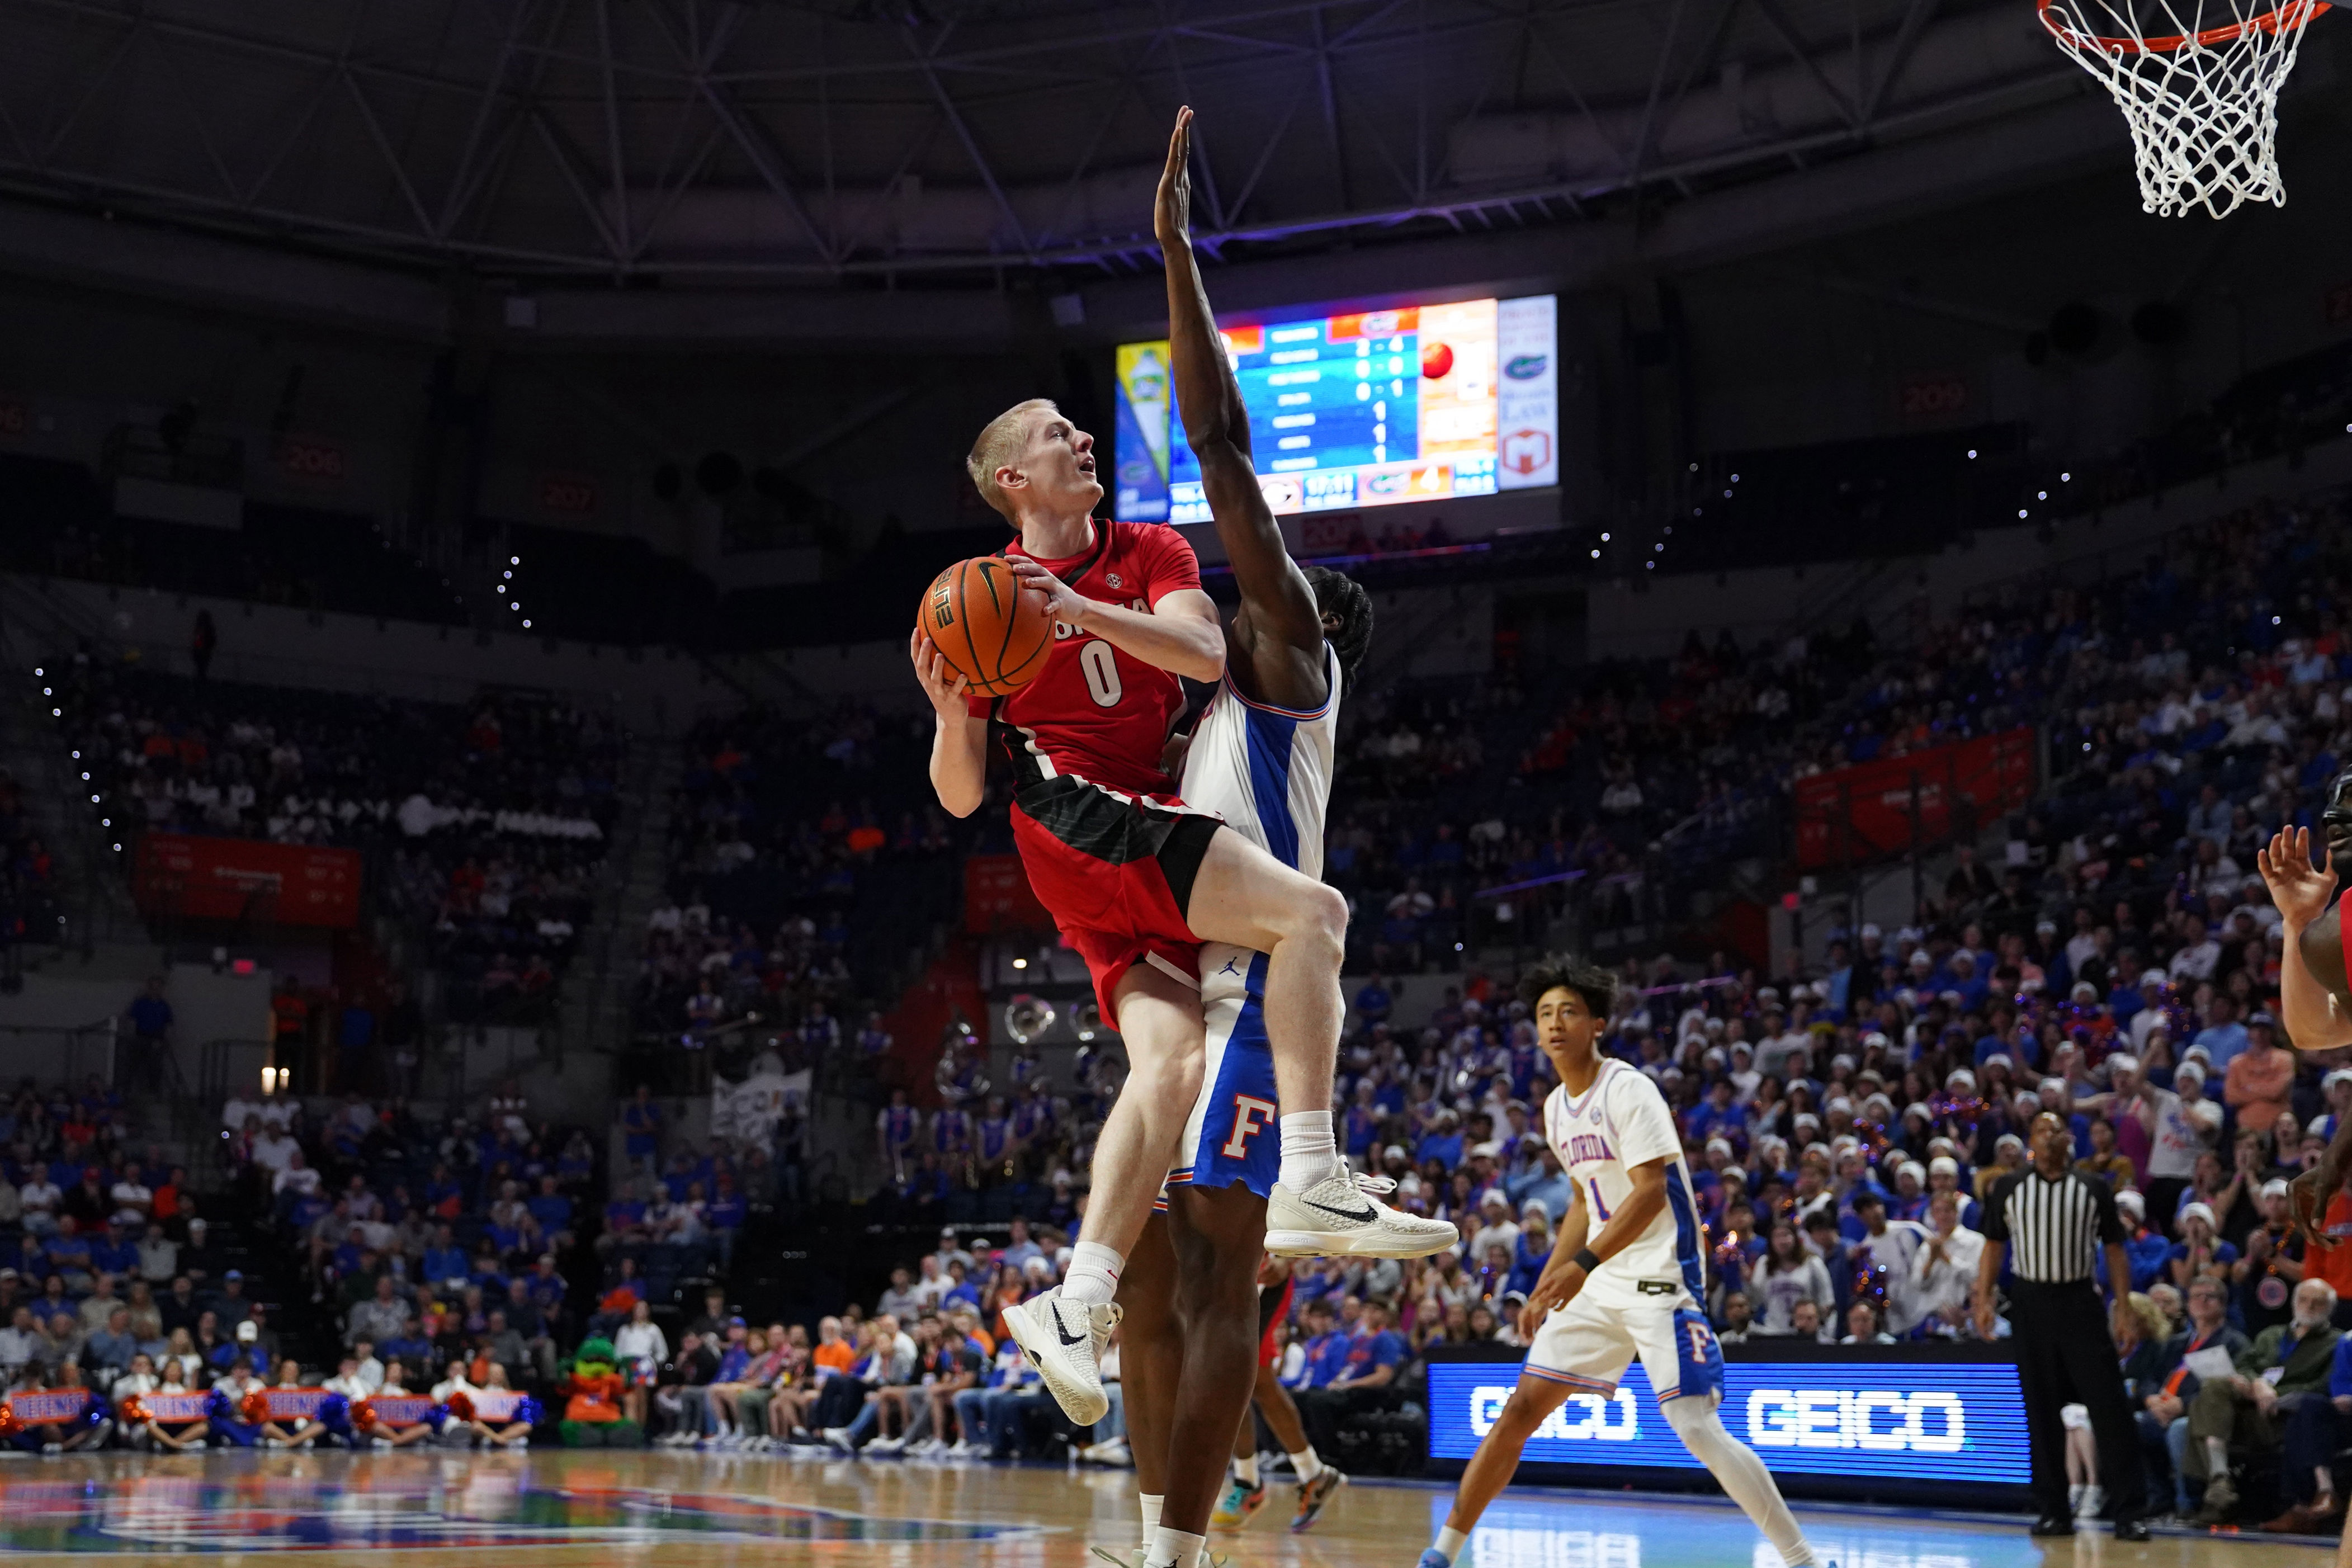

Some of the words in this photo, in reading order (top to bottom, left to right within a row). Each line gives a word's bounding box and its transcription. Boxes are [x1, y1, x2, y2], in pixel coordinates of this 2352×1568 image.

[1373, 400, 1386, 422] 1
[1373, 423, 1386, 443] 1
[1420, 465, 1441, 492] 4
[1107, 574, 1121, 587] SEC
[1080, 640, 1122, 707] 0
[1221, 1093, 1277, 1161] F
[1590, 1177, 1611, 1221] 1
[1687, 1320, 1711, 1363] F
[1470, 1386, 1638, 1440] GCO
[1746, 1389, 1966, 1452] GEICO
